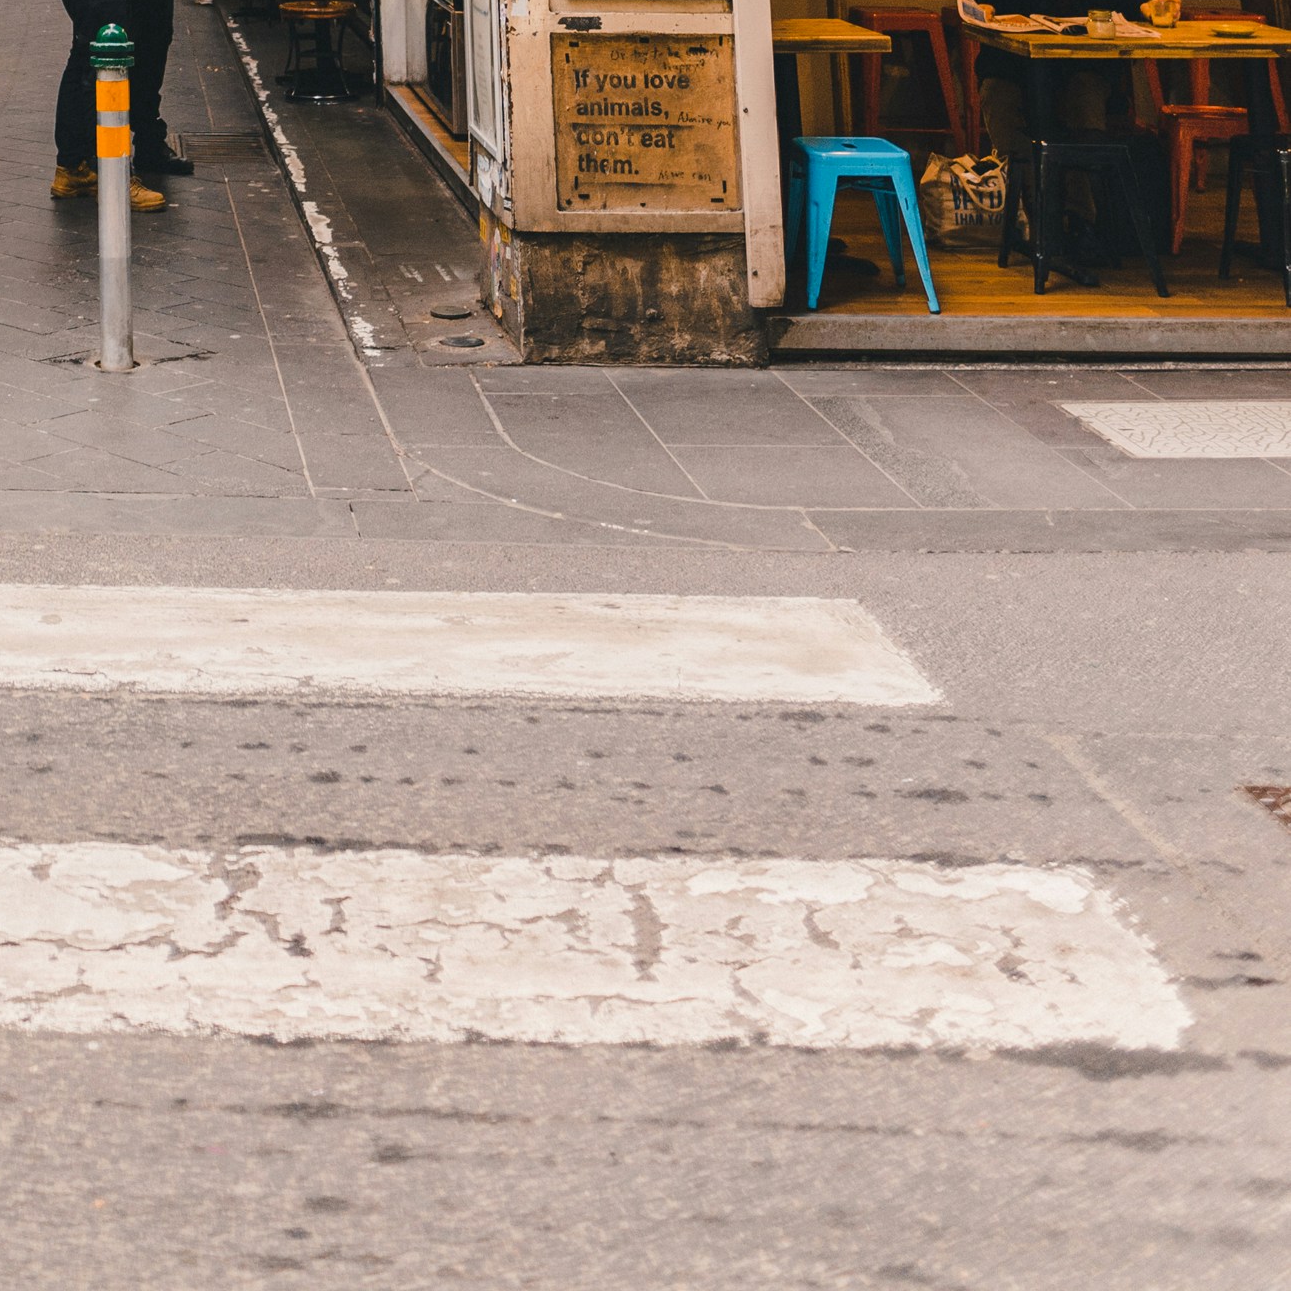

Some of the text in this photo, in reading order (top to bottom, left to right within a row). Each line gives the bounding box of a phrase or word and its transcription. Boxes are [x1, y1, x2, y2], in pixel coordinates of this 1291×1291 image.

[574, 69, 690, 93] If you love
[576, 98, 669, 119] animals,
[576, 127, 675, 148] don't eat
[578, 153, 639, 175] them.
